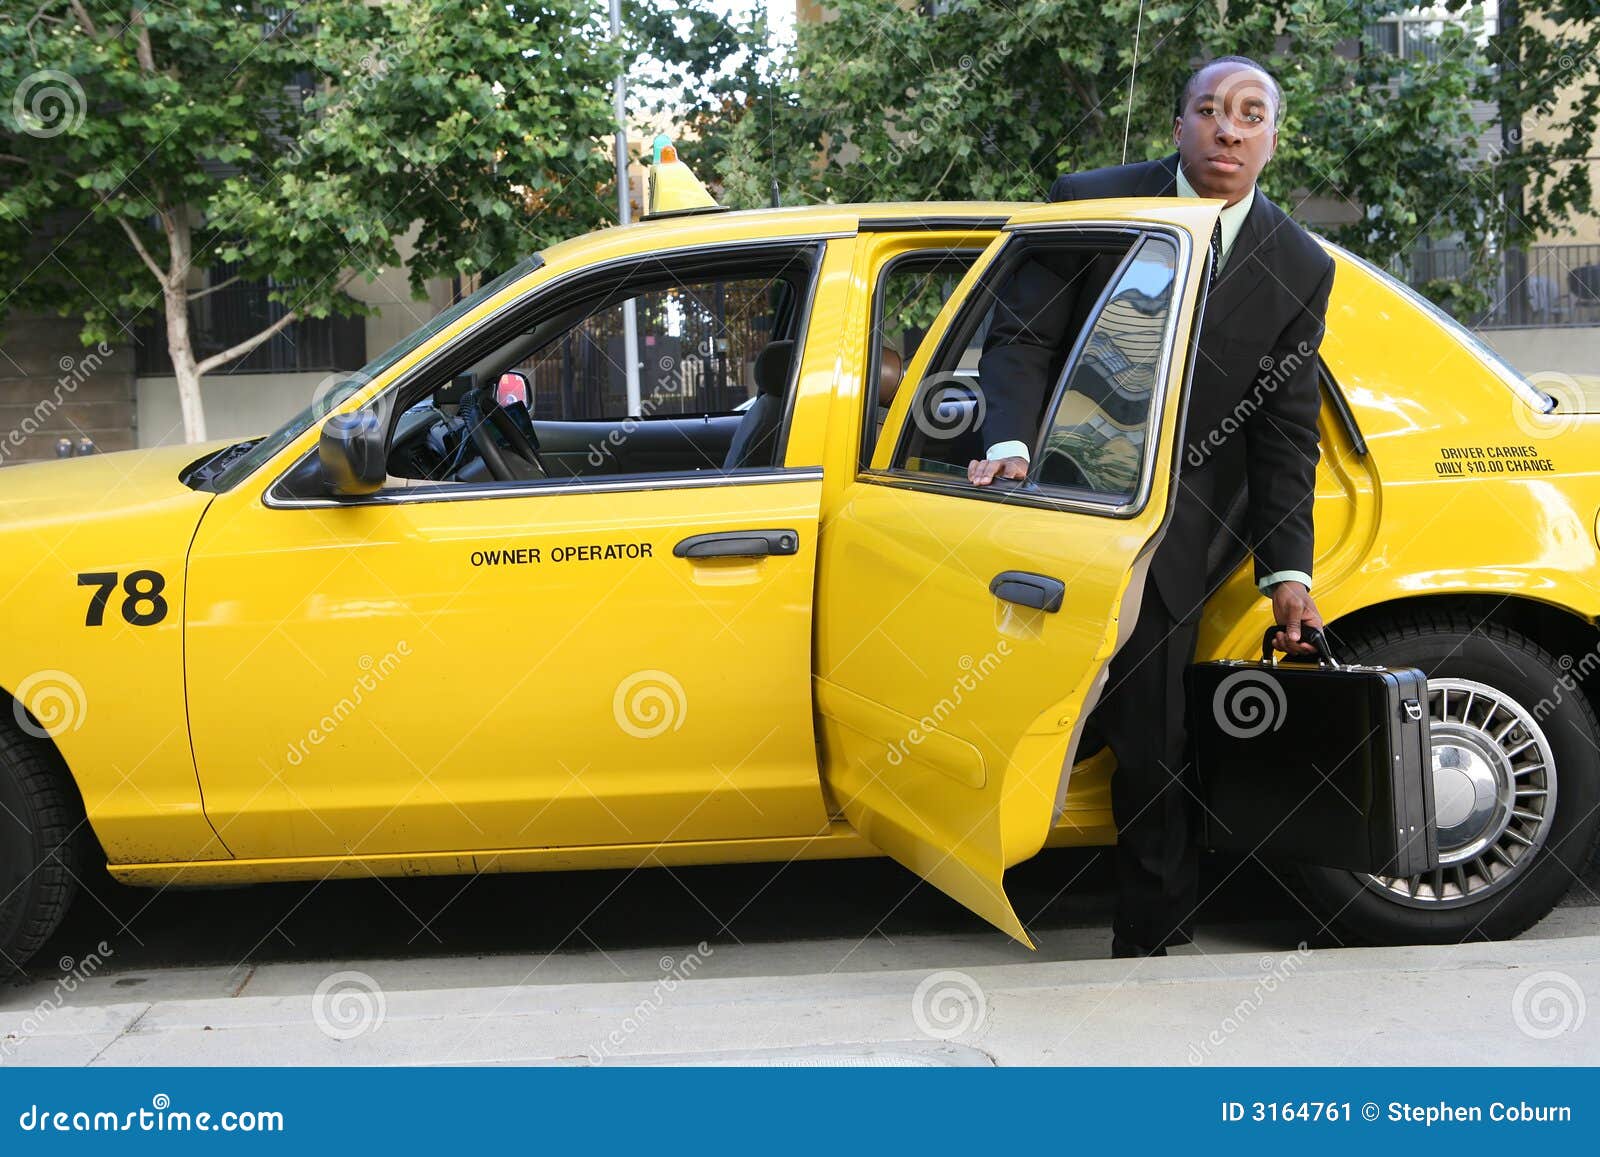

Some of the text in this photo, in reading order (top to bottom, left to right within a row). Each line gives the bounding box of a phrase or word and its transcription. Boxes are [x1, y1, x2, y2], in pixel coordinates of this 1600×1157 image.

[1441, 446, 1537, 459] DRIVER CARRIES
[1435, 460, 1555, 474] ONLY $10.00 CHANGE
[470, 543, 653, 567] OWNER OPERATOR
[77, 570, 168, 627] 78
